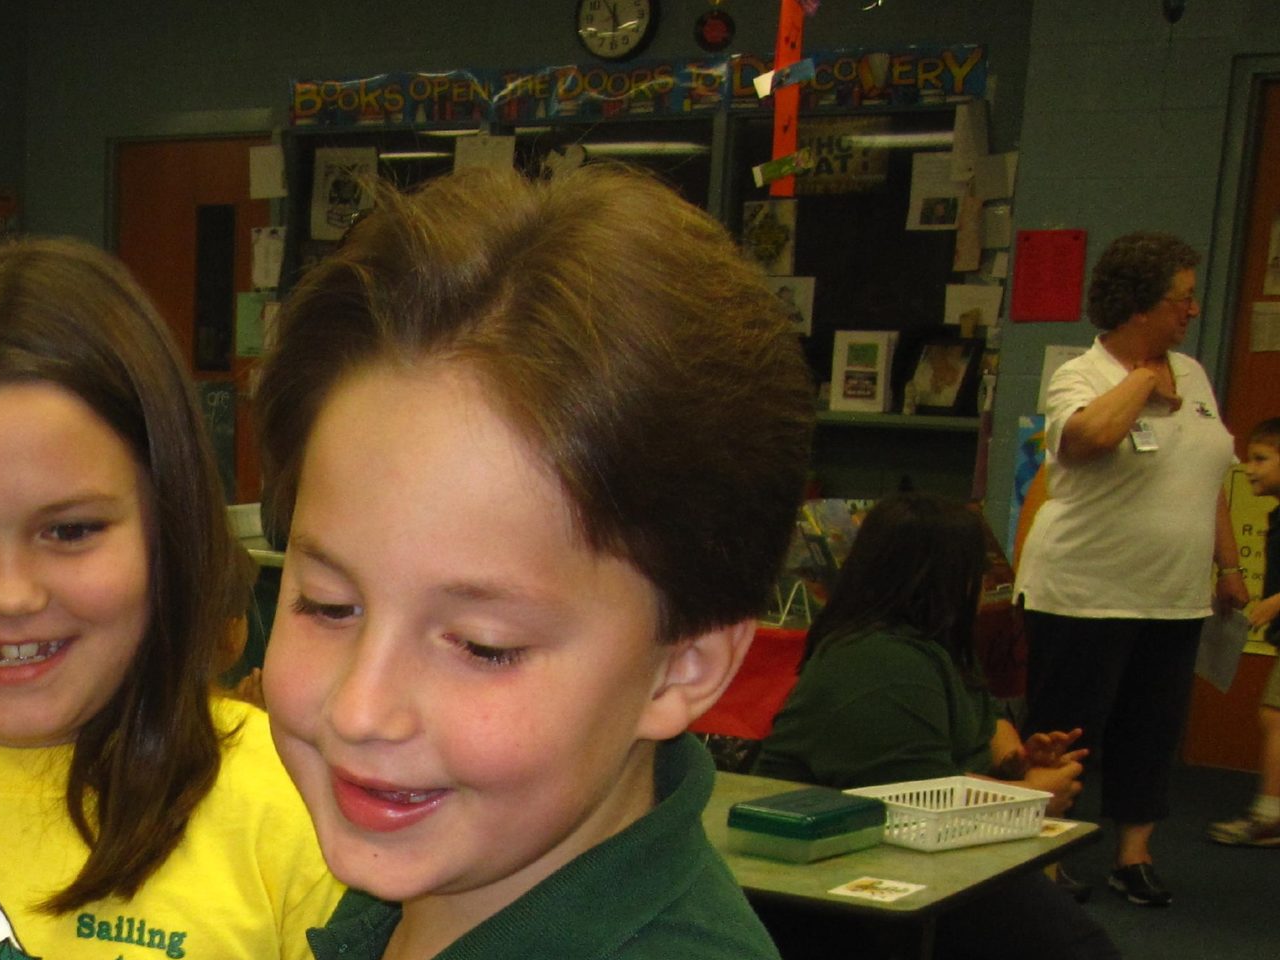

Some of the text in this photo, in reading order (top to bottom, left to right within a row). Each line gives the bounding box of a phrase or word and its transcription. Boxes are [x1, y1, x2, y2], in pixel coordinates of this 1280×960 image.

[294, 80, 405, 116] BOOKS
[409, 75, 490, 102] OPEN
[556, 64, 675, 99] DOORS
[76, 912, 188, 960] Sailing
